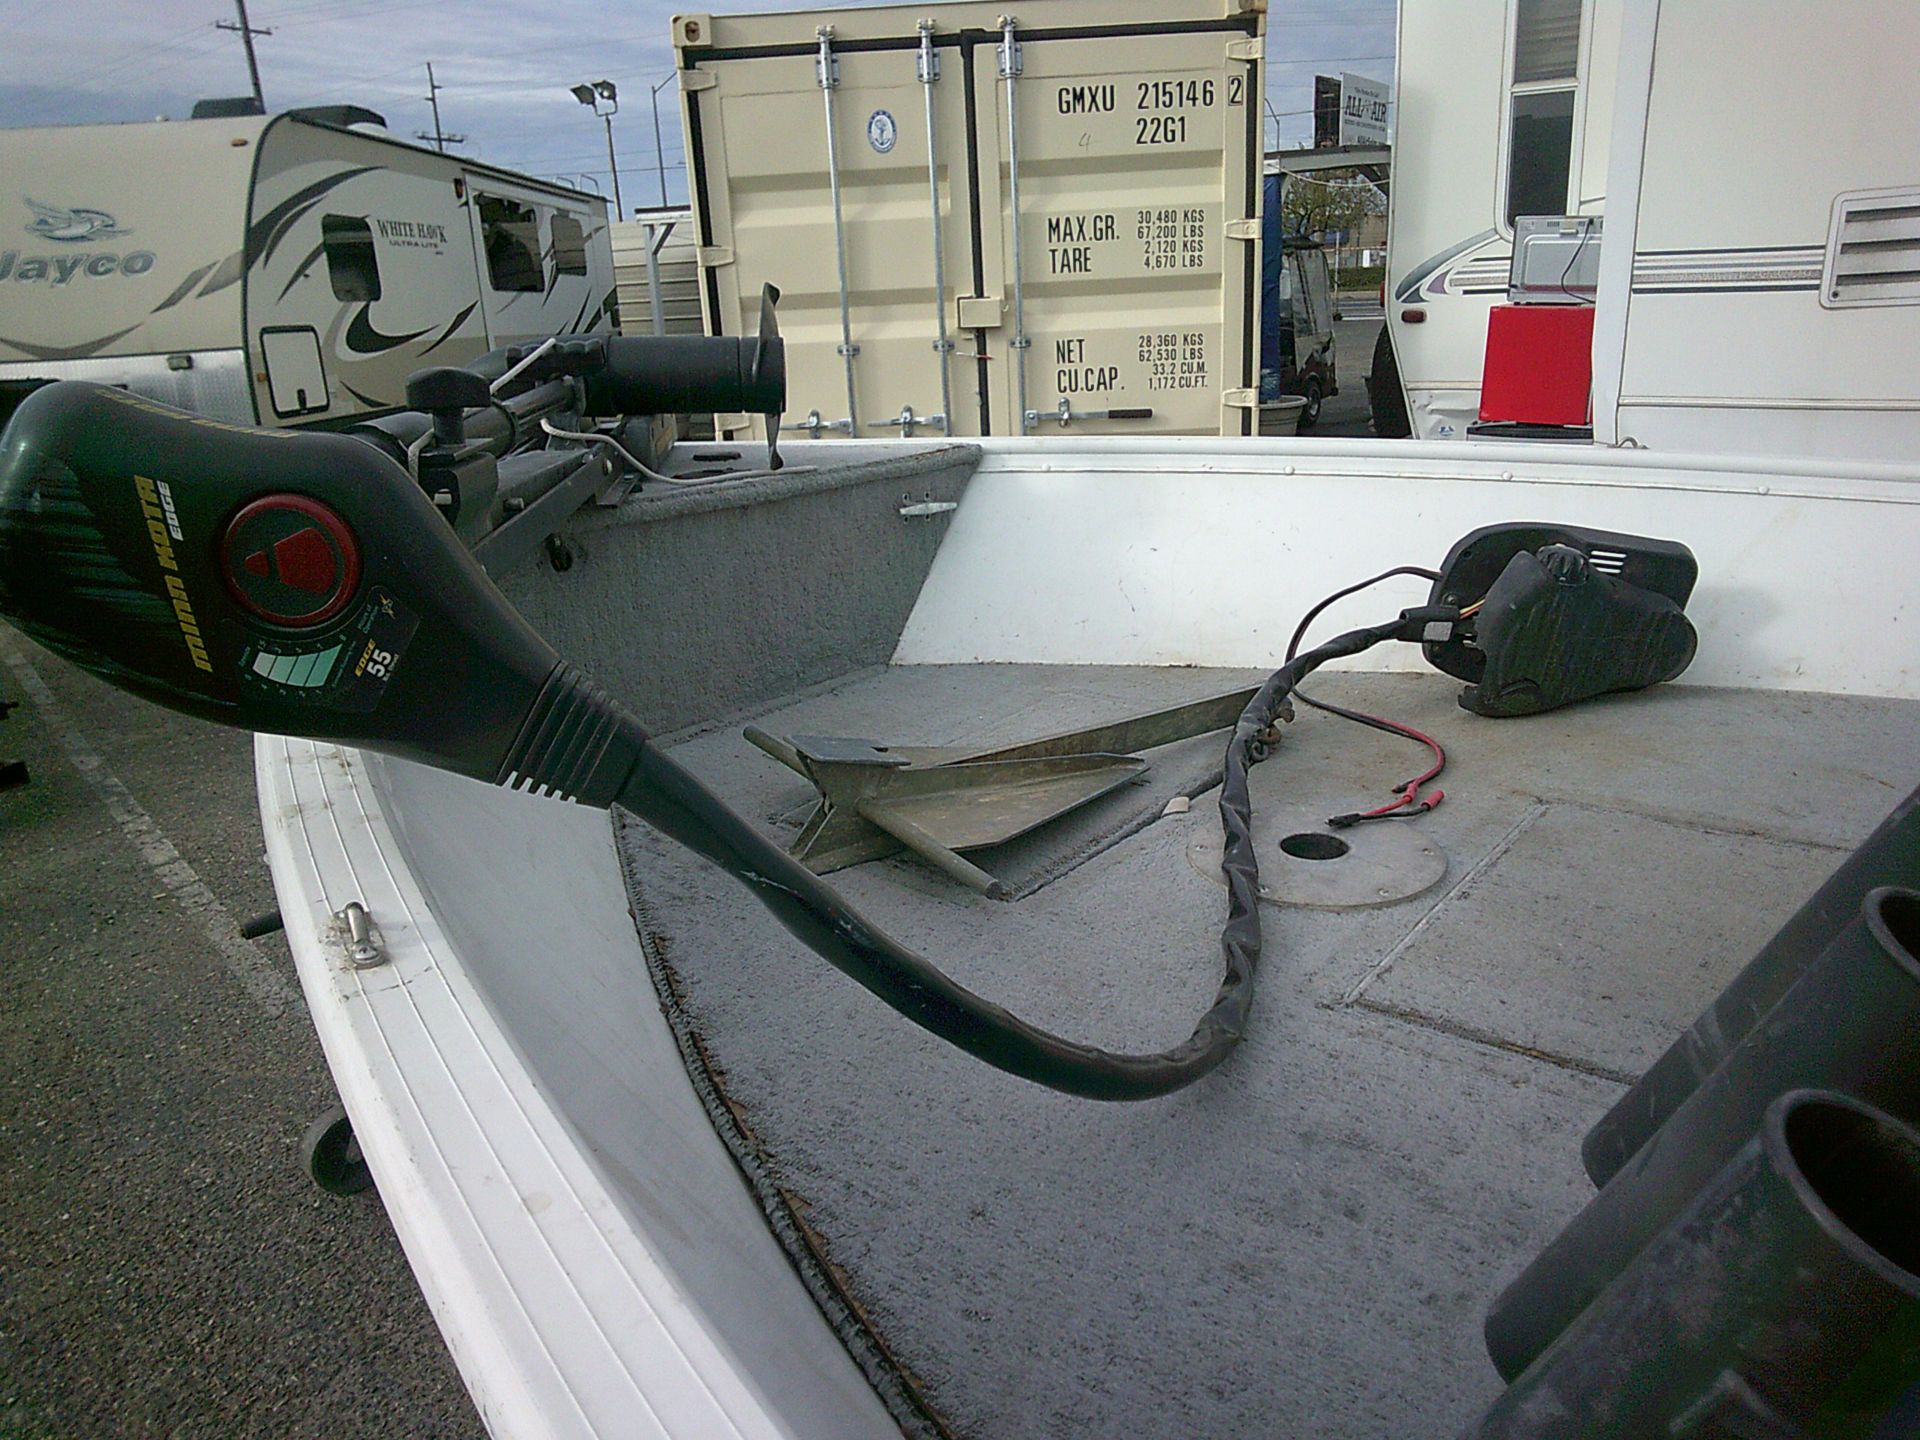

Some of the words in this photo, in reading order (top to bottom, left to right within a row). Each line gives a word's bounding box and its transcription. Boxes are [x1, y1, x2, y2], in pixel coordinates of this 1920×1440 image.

[1058, 84, 1115, 114] GMXU
[1137, 79, 1214, 110] 215146
[1229, 77, 1243, 105] 2
[1344, 95, 1363, 118] ALL
[1370, 101, 1387, 123] AIR
[1136, 116, 1186, 144] 22G1
[376, 219, 415, 238] WHITE
[1048, 214, 1120, 243] MAX.GR.
[1137, 210, 1177, 225] 30,480
[1183, 209, 1205, 223] KGS
[1137, 225, 1177, 240] 67,200
[1182, 225, 1204, 238] LBS
[1049, 247, 1092, 274] TARE
[1144, 241, 1177, 255] 2,120
[1182, 240, 1204, 253] KGS
[0, 250, 157, 288] Jayco
[1144, 255, 1176, 270] 4,670
[1182, 254, 1203, 268] LBS
[1056, 339, 1085, 364] NET
[1138, 334, 1177, 349] 28,360
[1182, 333, 1204, 347] KGS
[1138, 349, 1177, 363] 62,530
[1182, 348, 1203, 361] LBS
[1057, 367, 1125, 393] CU.CAP.
[1152, 362, 1176, 376] 33.2
[1180, 362, 1208, 375] CU.M.
[1148, 376, 1176, 390] 1,172
[1178, 375, 1208, 389] CU.FT.
[133, 474, 179, 572] KOTA
[156, 479, 184, 542] EDGE
[164, 575, 213, 673] MINN
[354, 638, 376, 678] EDGE
[365, 649, 392, 679] 55
